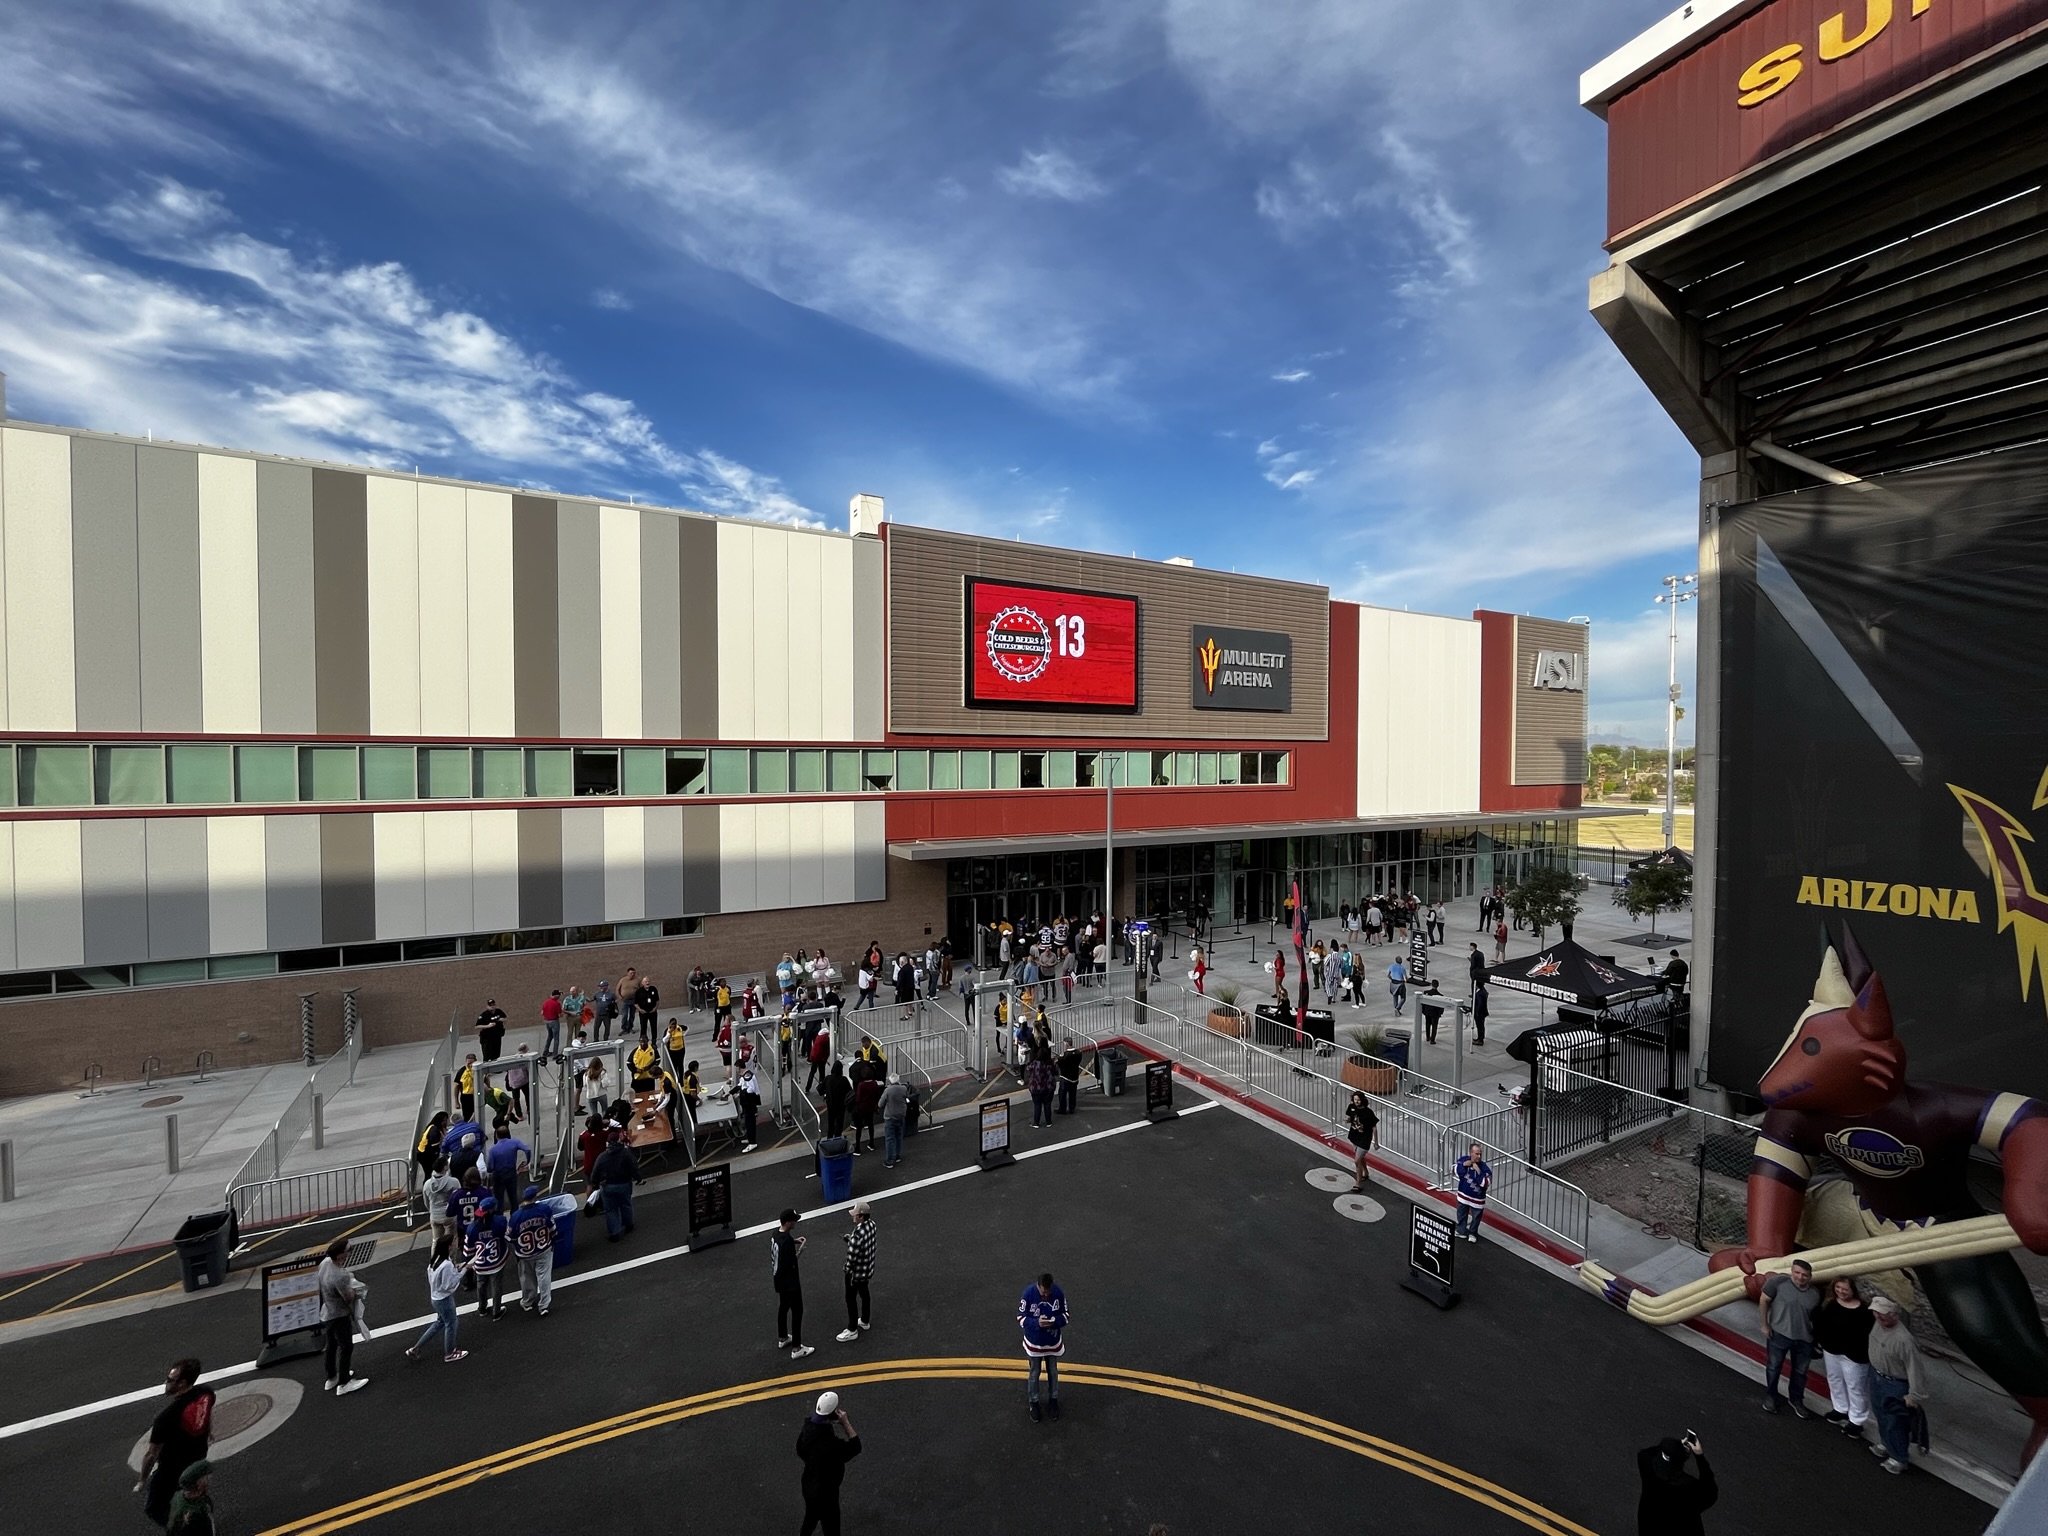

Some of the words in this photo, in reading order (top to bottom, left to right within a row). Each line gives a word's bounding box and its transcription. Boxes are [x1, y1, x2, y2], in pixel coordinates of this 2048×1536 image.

[1737, 0, 1931, 107] SU
[994, 634, 1014, 642] COLD
[1015, 636, 1039, 644] BEERS
[994, 642, 1045, 651] CHEESEBURGERS
[1055, 614, 1085, 658] 13
[1222, 649, 1286, 669] MULLETT
[1533, 650, 1584, 691] ASU
[1221, 670, 1273, 688] ARENA
[1796, 875, 1981, 924] ARIZONA
[1489, 974, 1530, 992] ARIZONA
[1530, 982, 1578, 1004] COYOTES
[1825, 1134, 1923, 1168] COYOTES
[462, 1204, 475, 1226] 9
[1415, 1212, 1452, 1236] ADDITIONAL
[518, 1225, 550, 1255] 99
[1415, 1228, 1451, 1251] NORTHEAST
[1416, 1221, 1449, 1243] ENTRANCE
[474, 1236, 501, 1265] 23
[1424, 1241, 1439, 1254] SIDE
